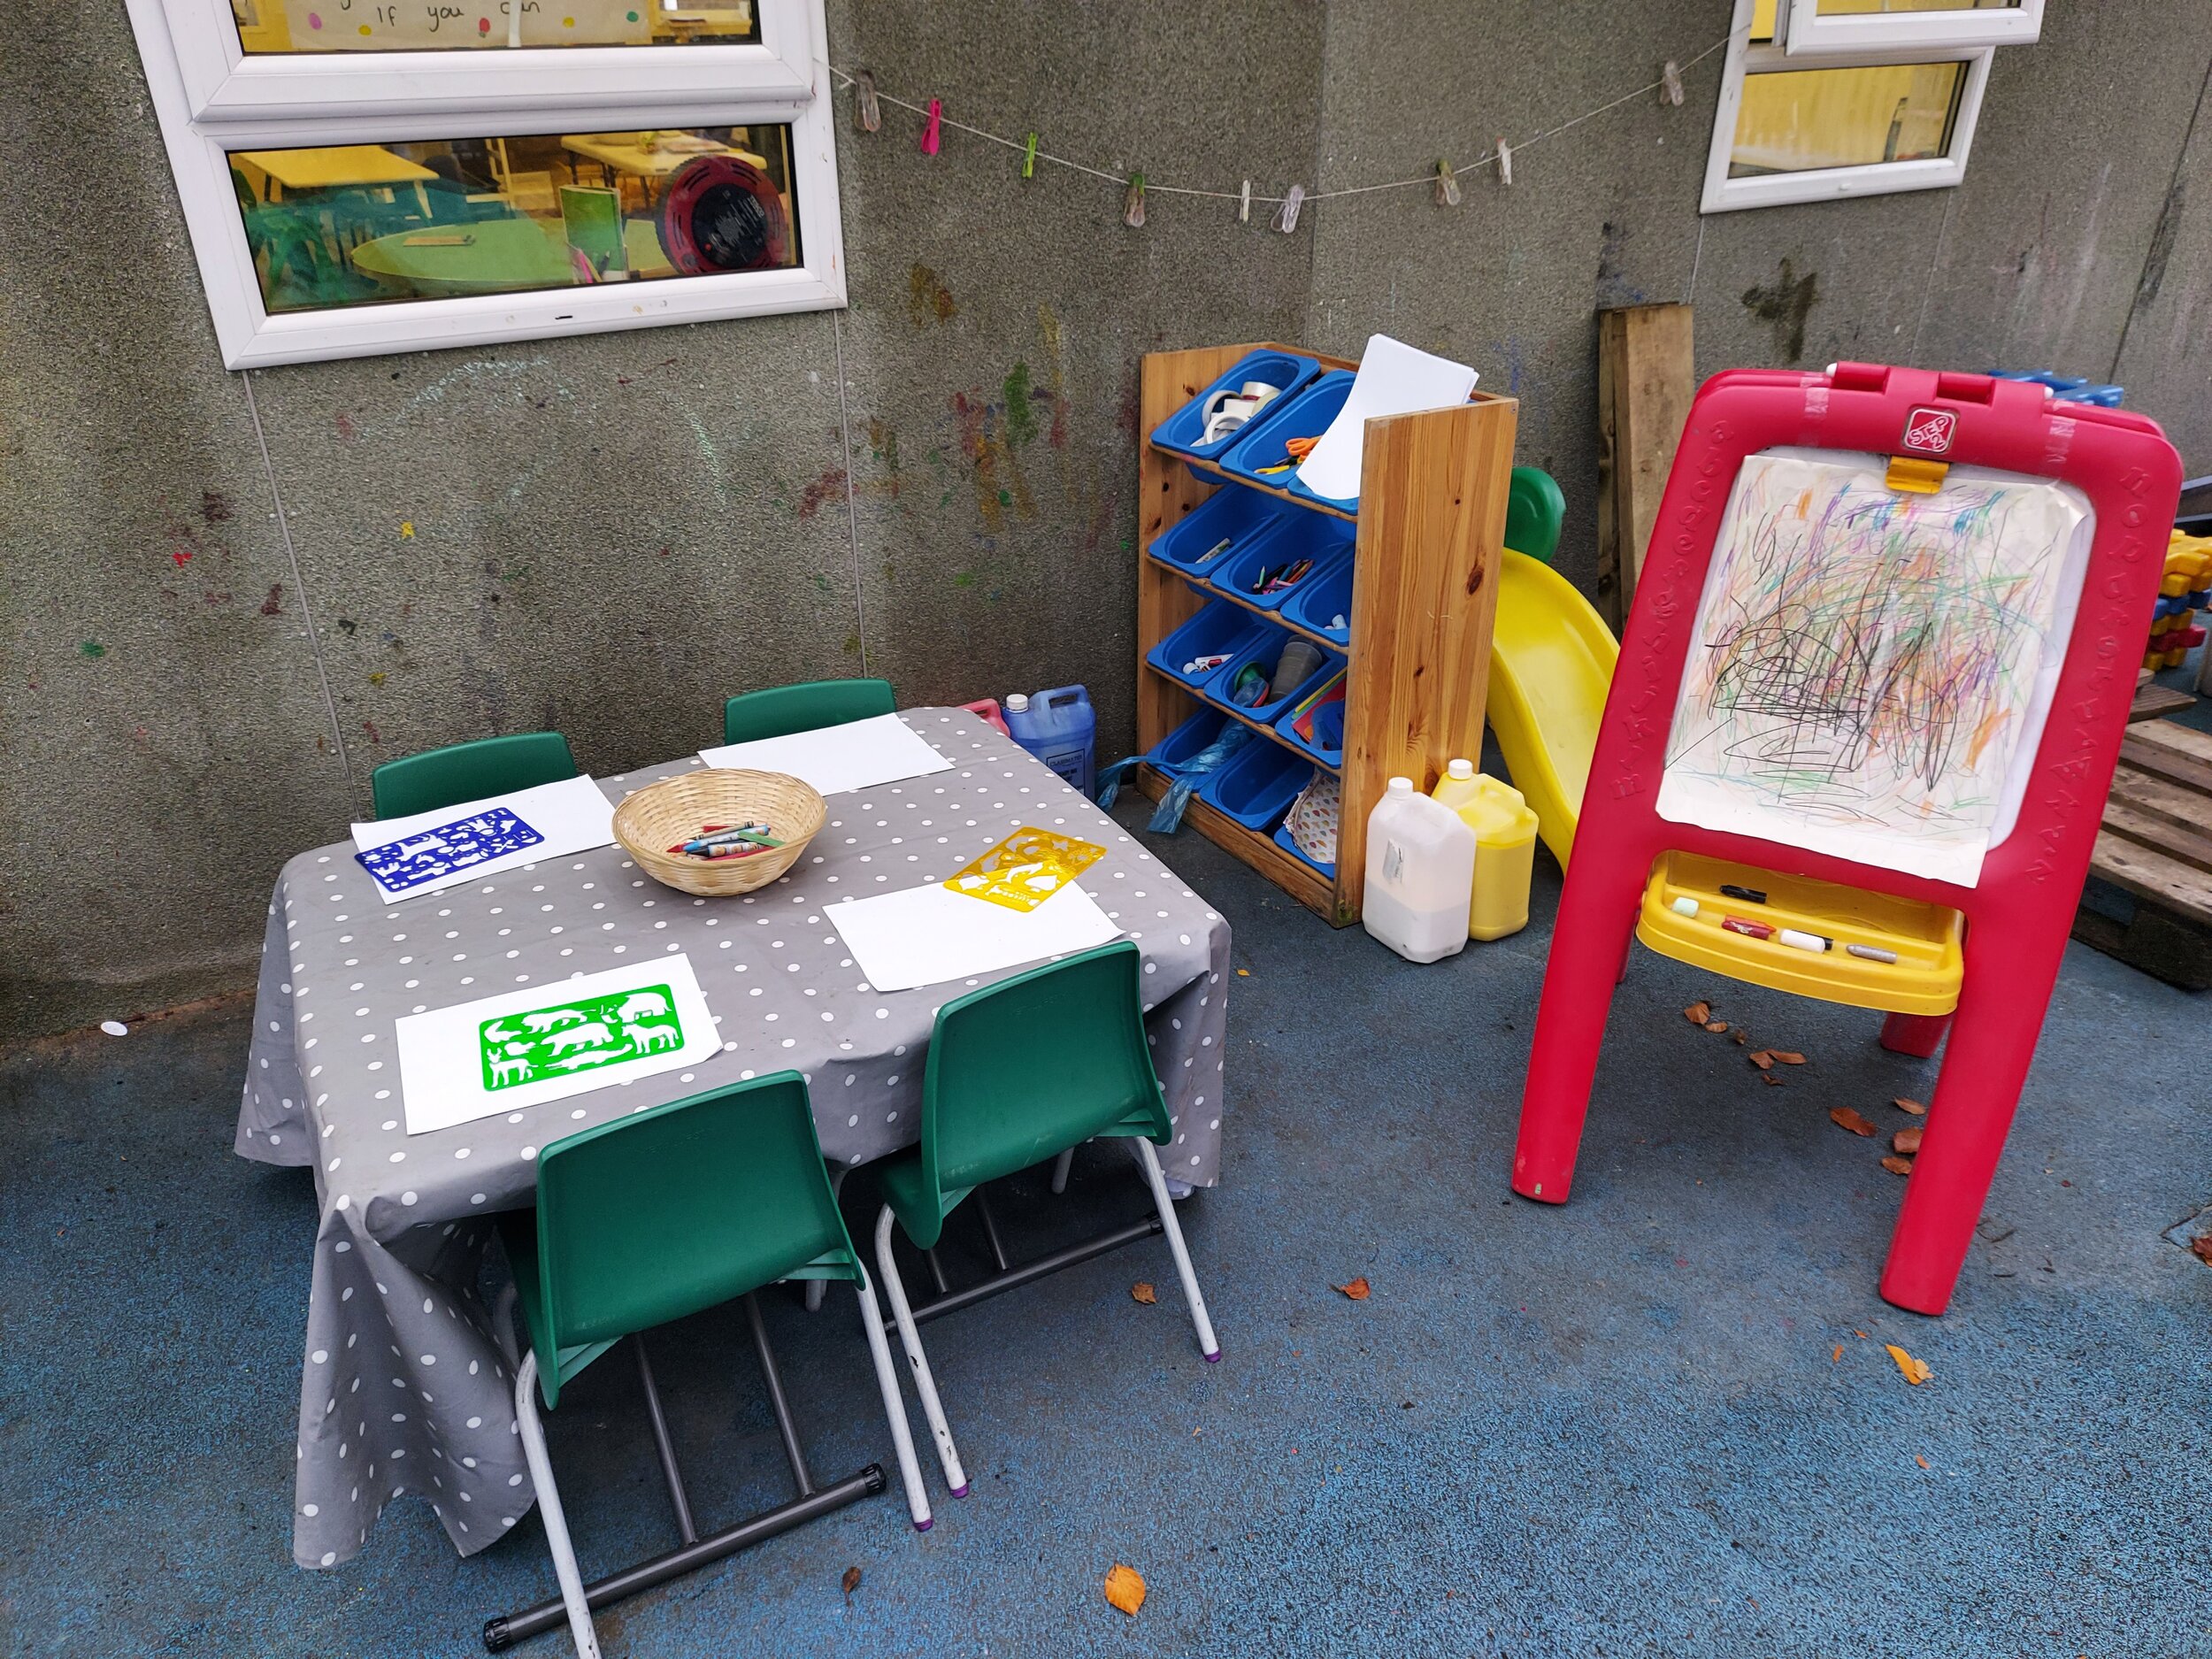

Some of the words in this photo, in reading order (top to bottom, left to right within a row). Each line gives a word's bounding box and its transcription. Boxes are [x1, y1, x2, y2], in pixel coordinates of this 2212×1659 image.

[427, 6, 465, 33] you
[1910, 417, 1949, 444] STEP
[1930, 434, 1947, 450] 2
